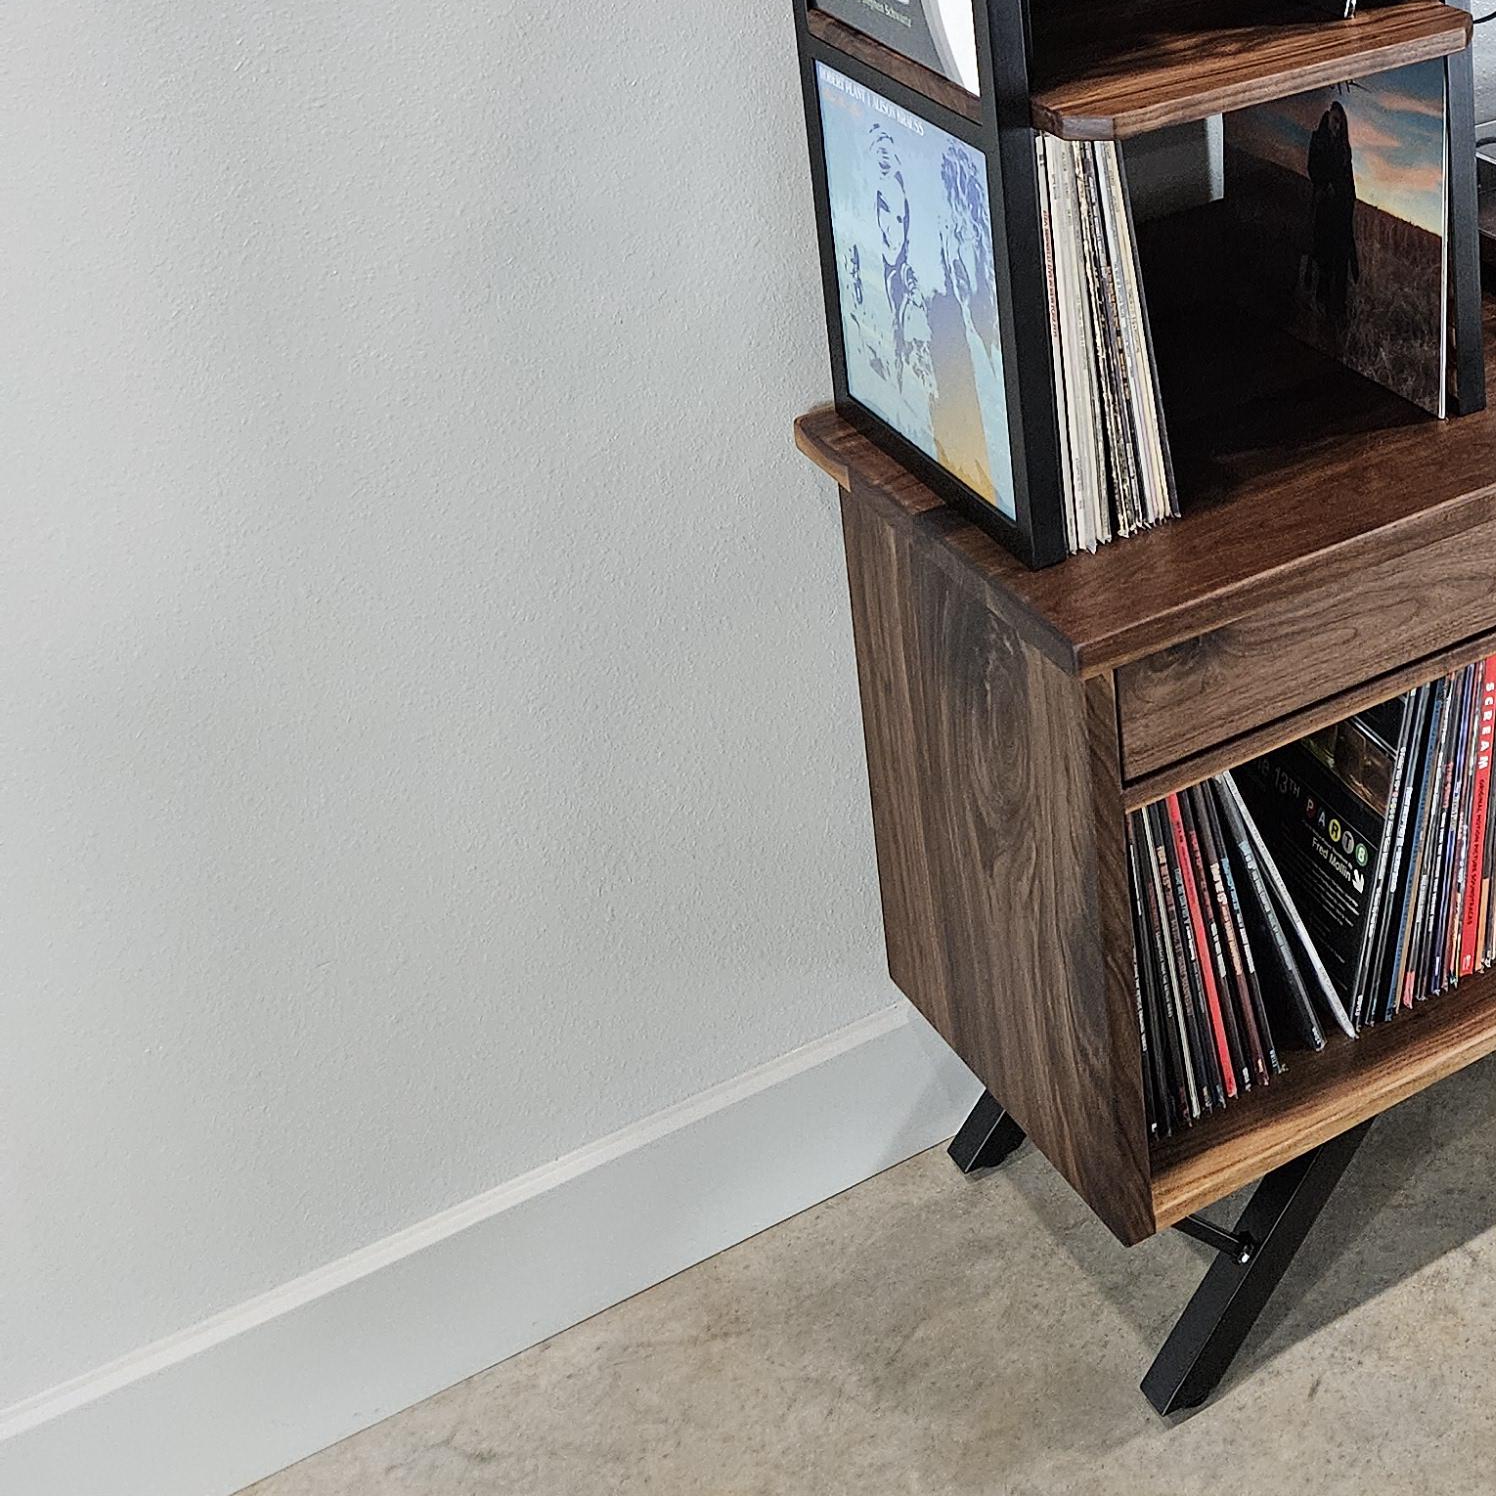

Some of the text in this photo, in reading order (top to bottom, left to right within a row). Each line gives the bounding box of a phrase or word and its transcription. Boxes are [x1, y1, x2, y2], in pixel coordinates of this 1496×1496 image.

[1476, 681, 1496, 772] SCREAM
[1273, 765, 1301, 799] 13TH
[1474, 778, 1486, 814] ORIGINAL
[1471, 813, 1483, 843] MOTION
[1311, 835, 1352, 883] Fred Mollin
[1469, 843, 1480, 873] PICTURE
